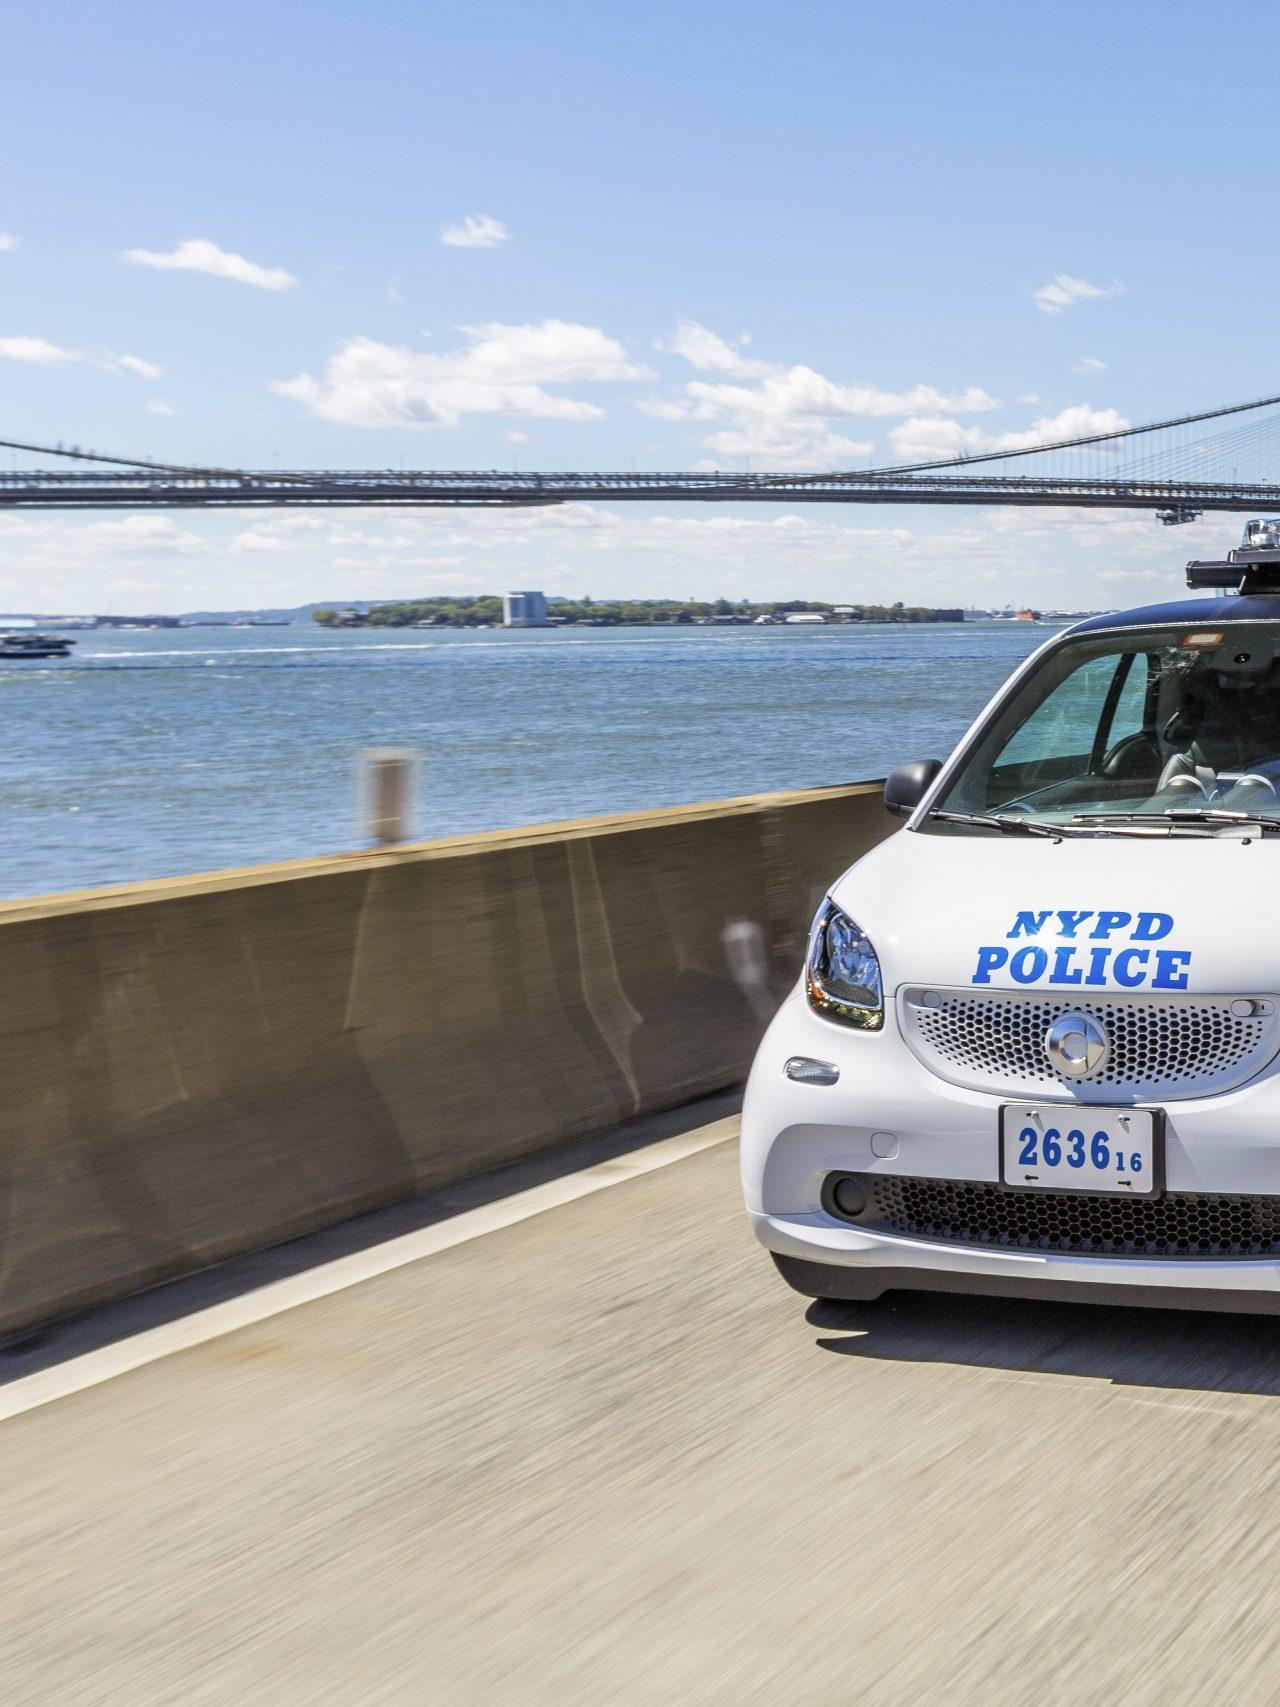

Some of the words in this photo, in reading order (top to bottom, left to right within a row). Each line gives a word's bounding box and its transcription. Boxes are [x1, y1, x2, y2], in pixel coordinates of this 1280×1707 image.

[1006, 911, 1174, 941] NYPD
[972, 946, 1192, 990] POLICE
[1018, 1127, 1110, 1169] 2636
[1116, 1151, 1142, 1172] 16
